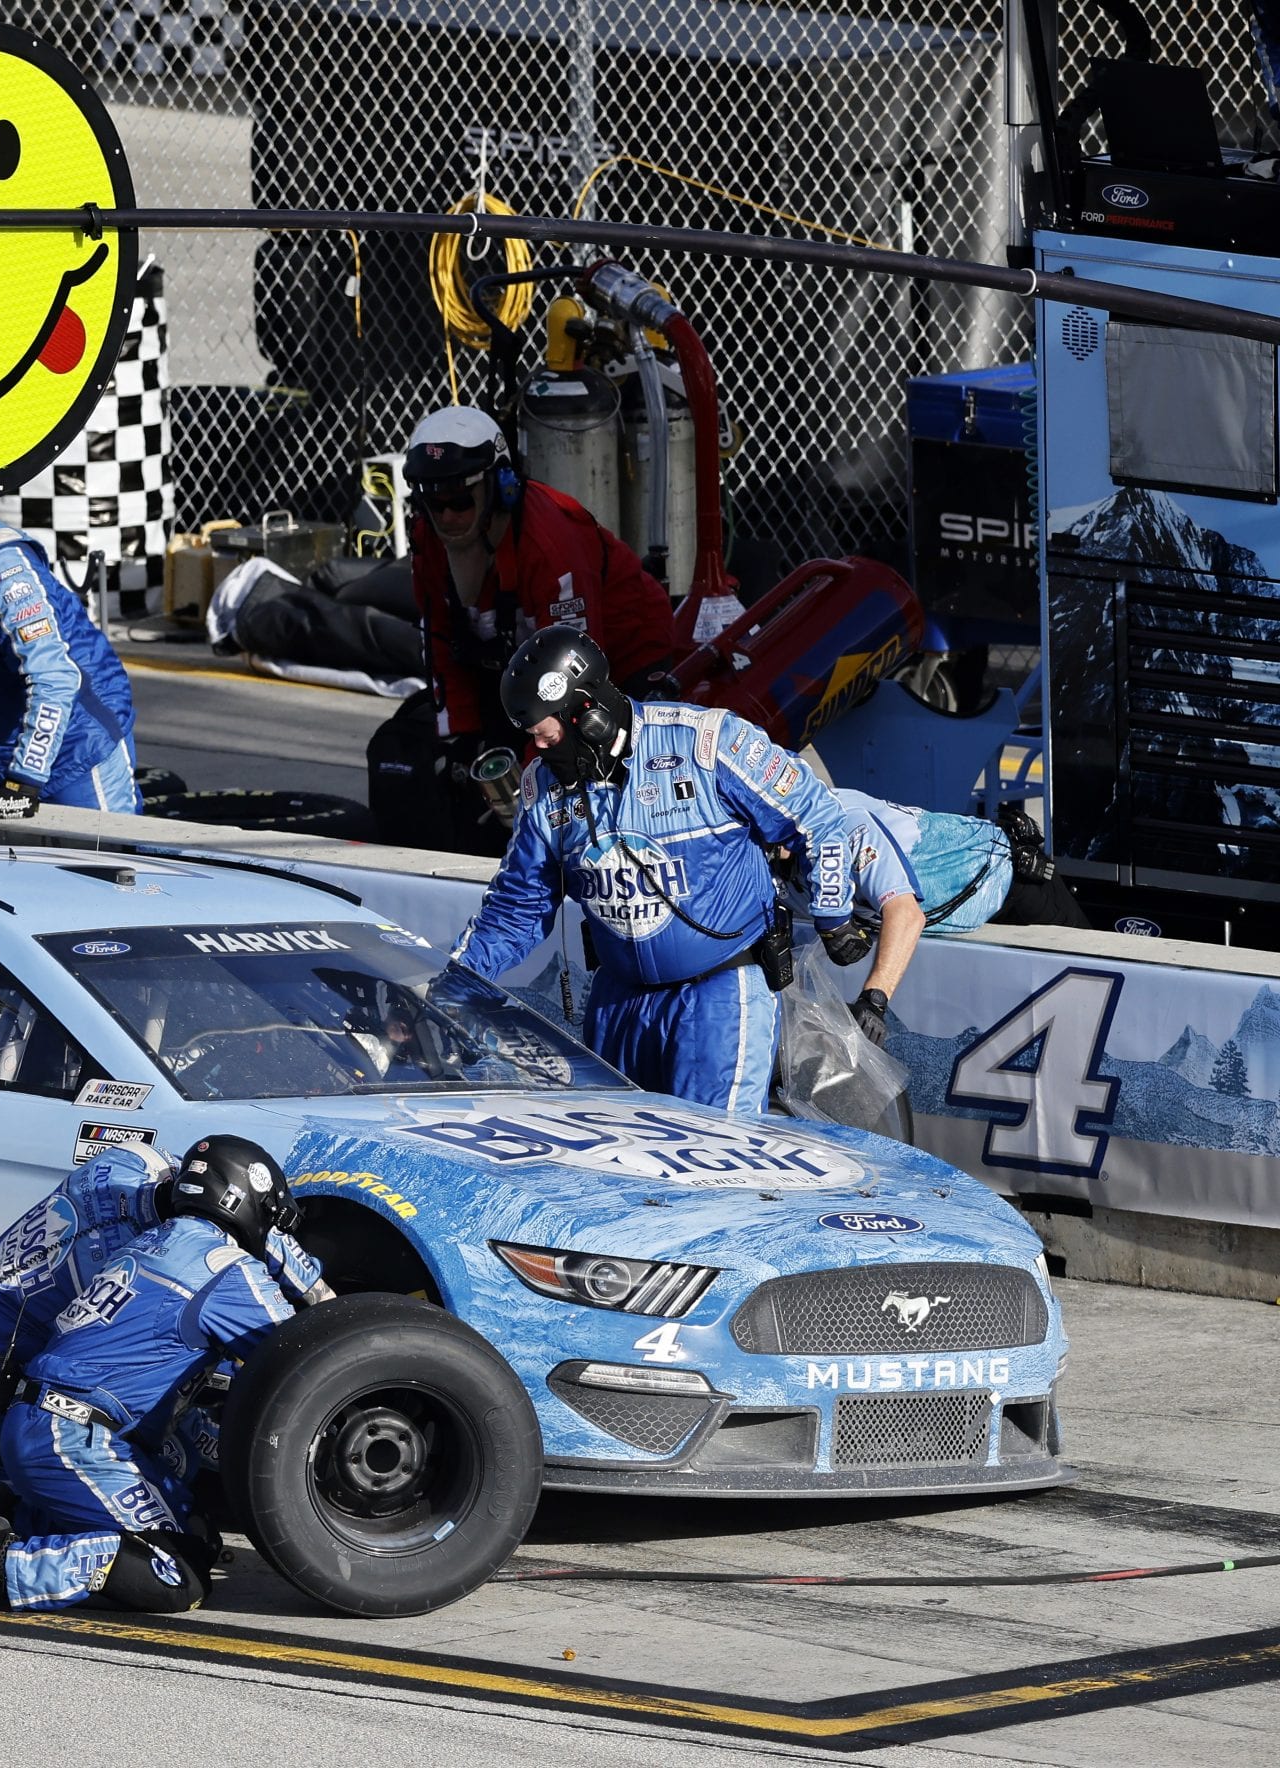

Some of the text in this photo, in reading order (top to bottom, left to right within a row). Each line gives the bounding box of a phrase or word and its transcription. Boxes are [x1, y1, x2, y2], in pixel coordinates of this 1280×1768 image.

[1081, 211, 1176, 231] FORD PERFORMANCE
[3, 584, 35, 605] BUSCH
[732, 652, 751, 670] 4
[538, 672, 568, 701] BUSCH
[24, 703, 61, 773] BUSCH
[746, 739, 768, 768] BUSCH
[636, 787, 660, 800] BUSCH
[651, 806, 691, 819] GOODYEAR
[580, 859, 688, 900] BUSCH
[820, 844, 842, 909] BUSCH
[598, 901, 665, 920] LIGHT
[184, 930, 352, 953] HARVICK
[945, 966, 1126, 1179] 4
[85, 1095, 133, 1107] RACE CAR
[102, 1083, 141, 1097] NASCAR
[102, 1128, 145, 1142] NASCAR
[248, 1163, 274, 1192] BUSCH
[688, 1176, 748, 1187] REWED
[633, 1323, 683, 1363] 4
[807, 1357, 1010, 1390] MUSTANG
